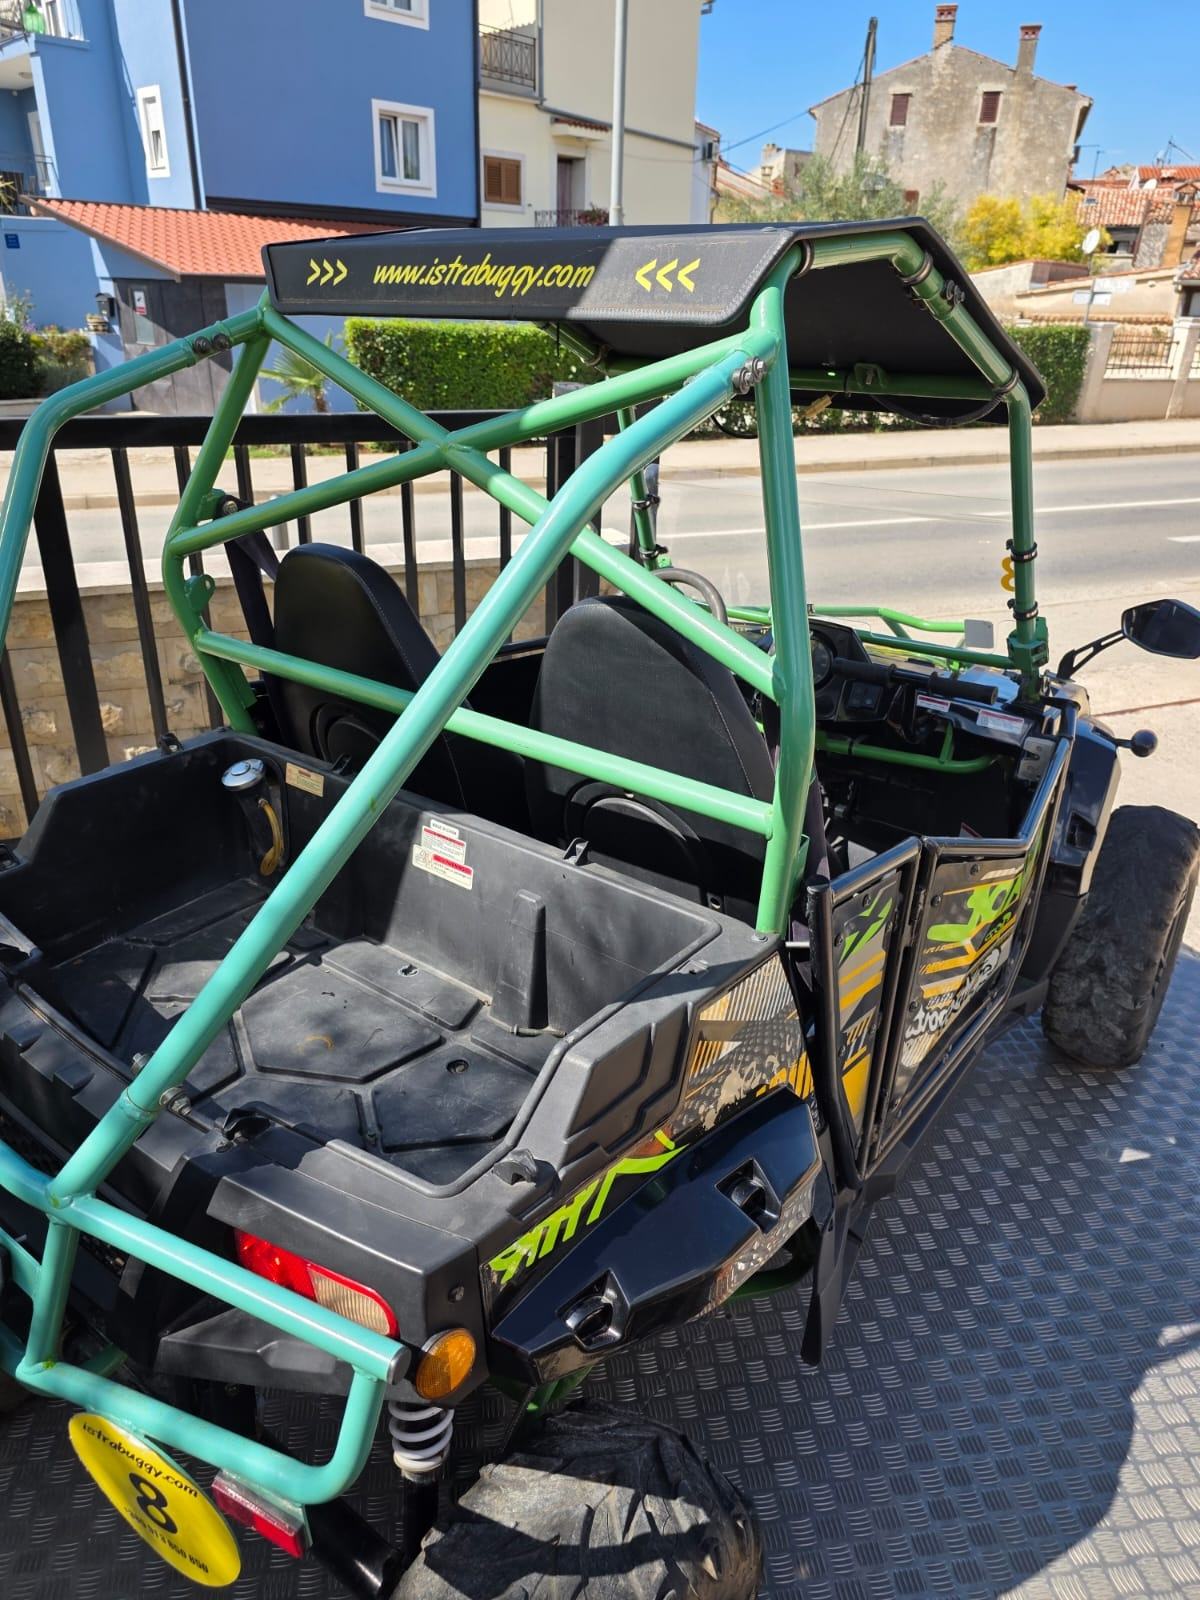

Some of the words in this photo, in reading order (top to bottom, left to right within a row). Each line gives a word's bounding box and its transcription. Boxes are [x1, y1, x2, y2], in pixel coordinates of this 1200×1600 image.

[373, 253, 596, 298] www.istrabuggy.com
[82, 1423, 199, 1499] istrabuggy.com
[128, 1472, 178, 1535] 8
